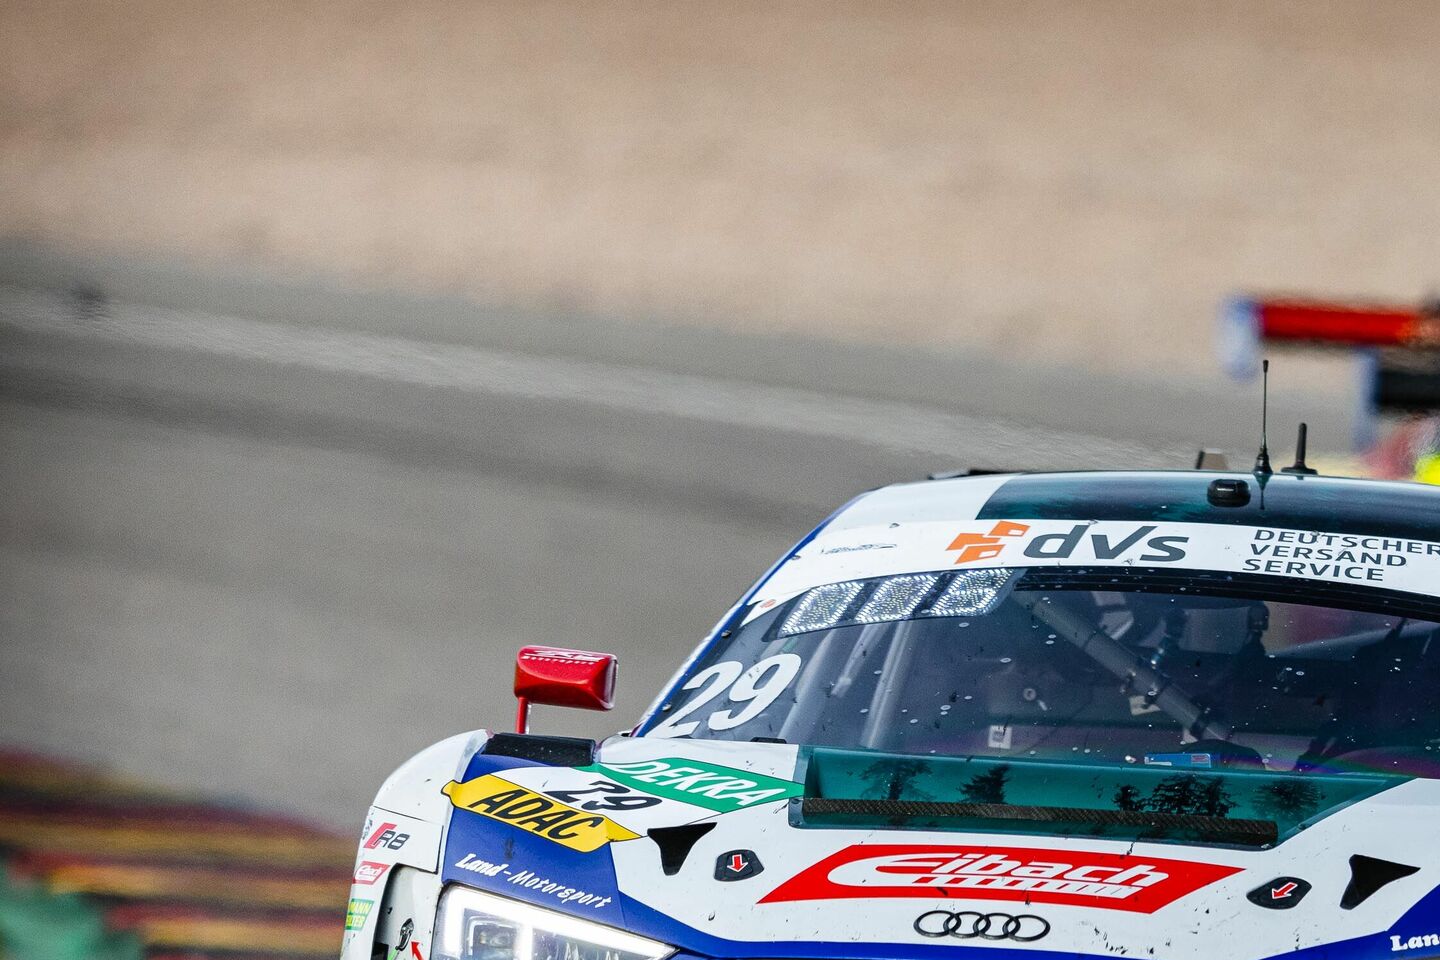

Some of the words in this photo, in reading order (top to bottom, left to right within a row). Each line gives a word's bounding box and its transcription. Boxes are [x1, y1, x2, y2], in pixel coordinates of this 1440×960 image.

[1023, 524, 1190, 562] dvs
[1249, 543, 1407, 567] VERSAND
[1241, 558, 1385, 582] SERVICE
[645, 653, 802, 738] 29
[543, 781, 662, 811] 29
[606, 759, 788, 807] DEKRA
[467, 788, 605, 841] ADAC
[372, 829, 411, 851] R8
[827, 852, 1170, 900] Eibach
